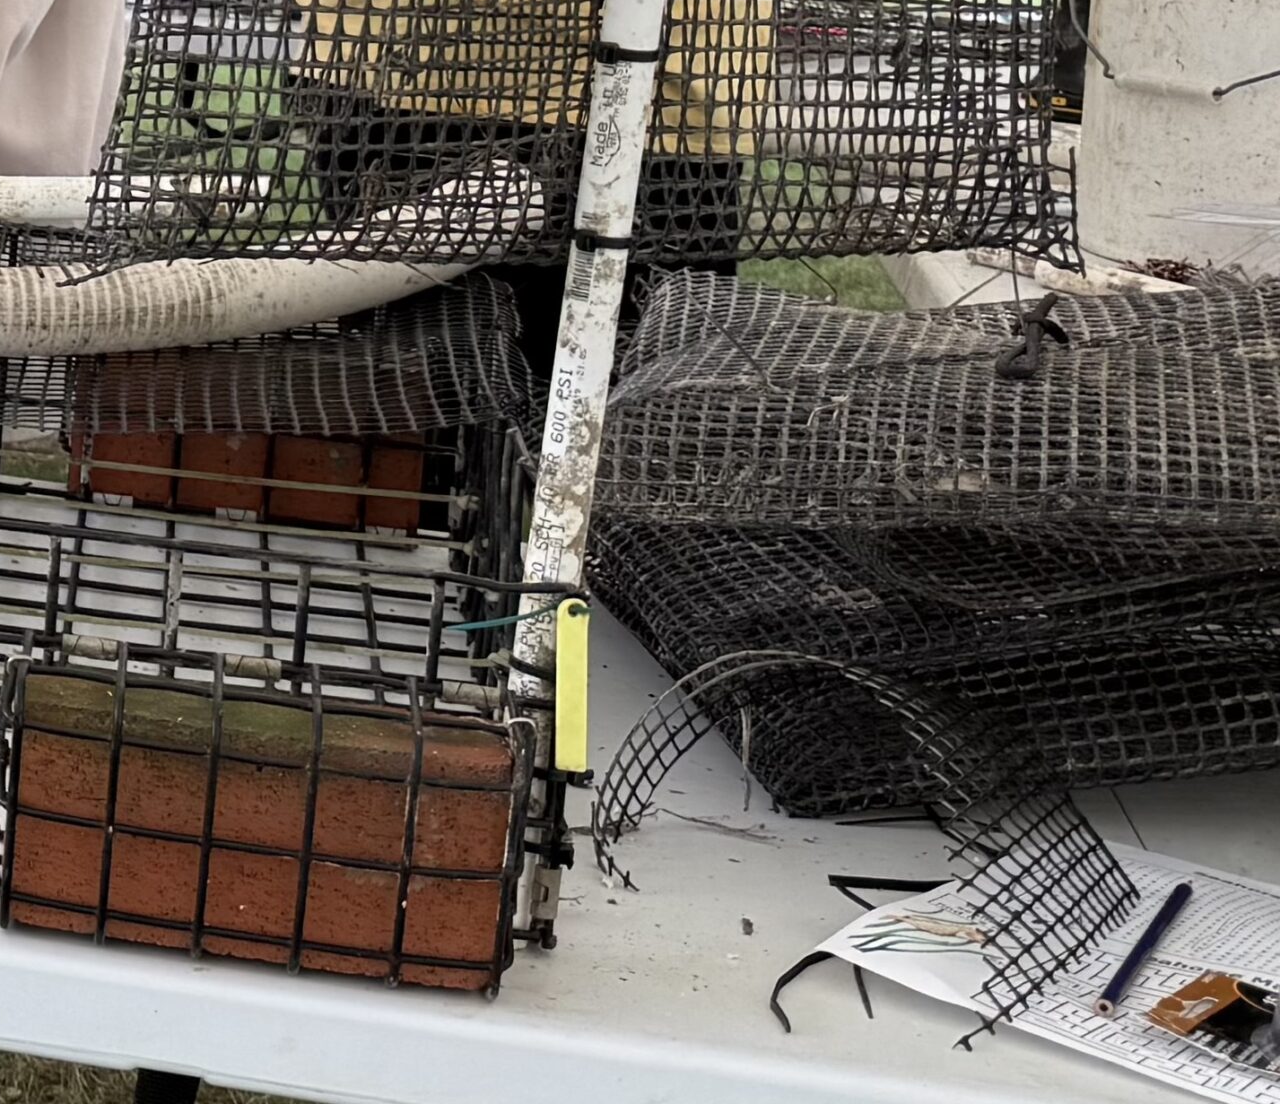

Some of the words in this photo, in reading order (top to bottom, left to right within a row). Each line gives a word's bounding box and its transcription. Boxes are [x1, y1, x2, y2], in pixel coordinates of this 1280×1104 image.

[590, 121, 608, 167] Made
[556, 368, 573, 401] PSI
[550, 410, 567, 444] 600
